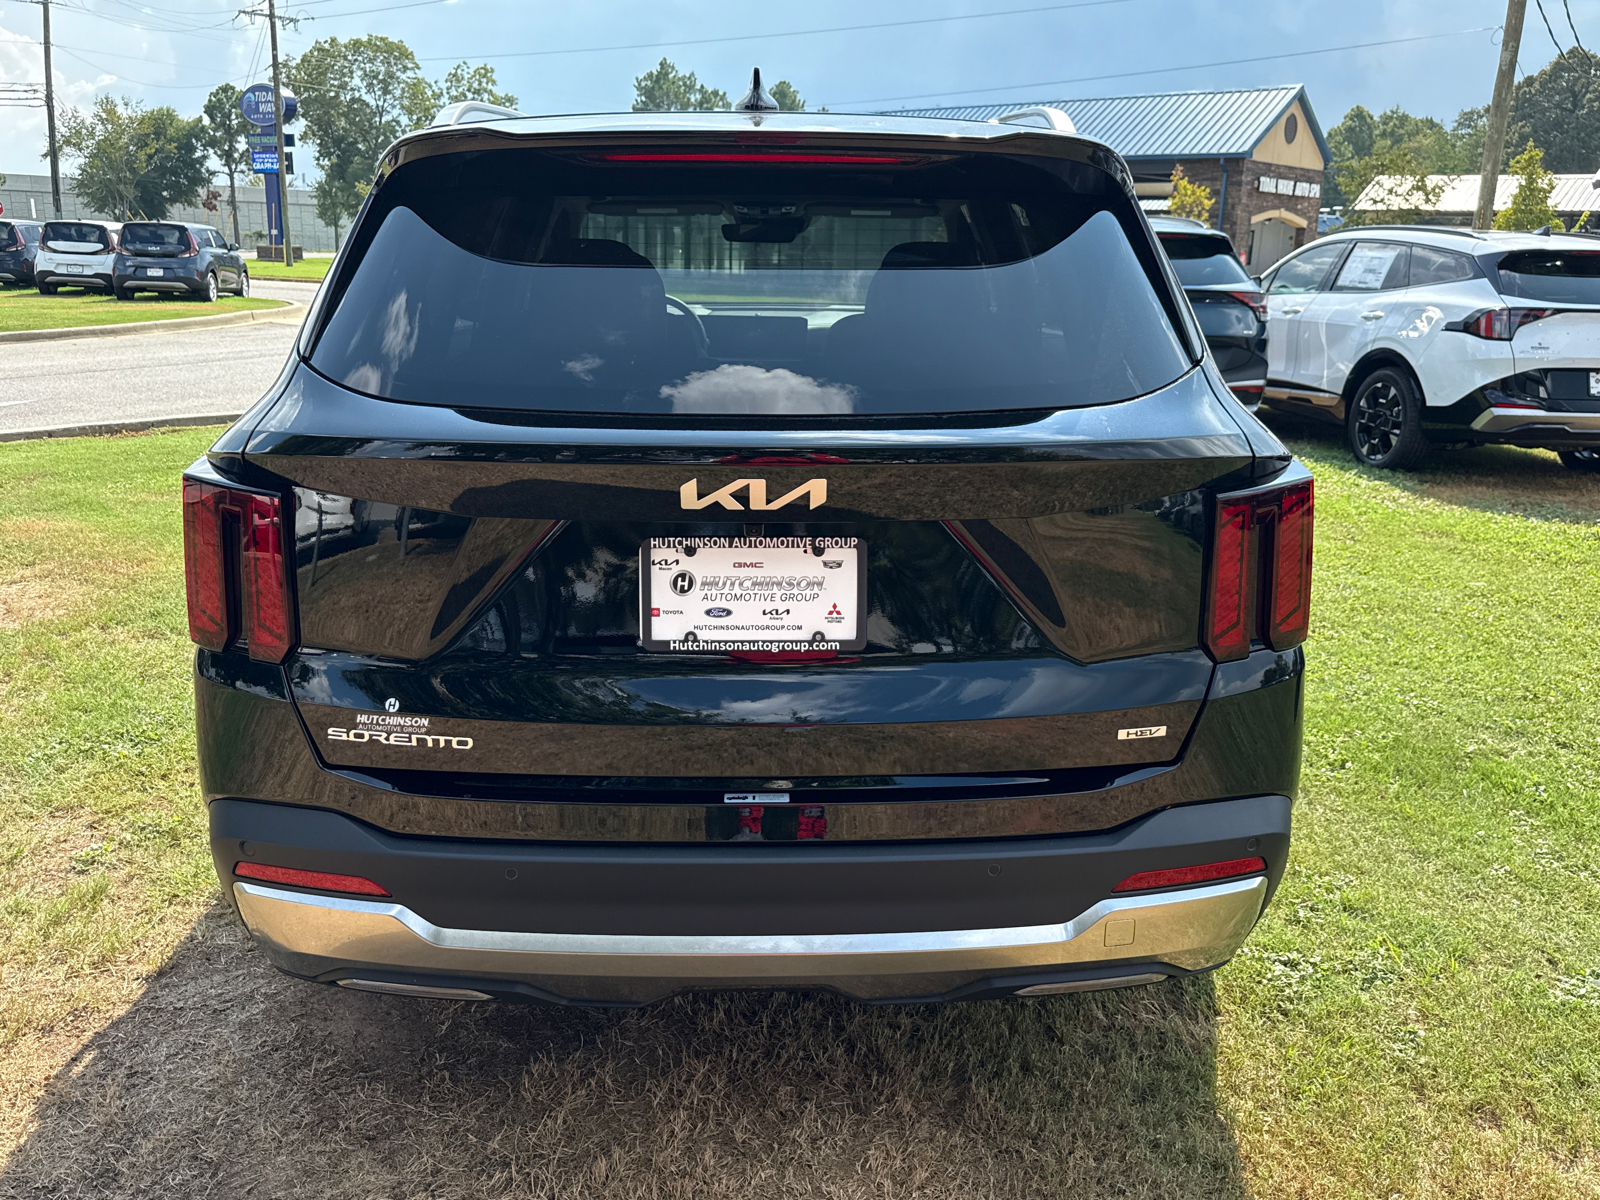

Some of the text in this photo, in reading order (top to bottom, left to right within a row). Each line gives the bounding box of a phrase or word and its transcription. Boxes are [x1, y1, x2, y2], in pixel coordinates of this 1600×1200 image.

[258, 103, 275, 113] WAV
[680, 478, 827, 510] KIA
[650, 537, 859, 549] HUTCHINSON AUTOMOTIVE GROUP
[651, 558, 680, 567] KIA
[699, 576, 826, 591] HUTCHINSON
[701, 593, 820, 602] AUTOMOTIVE GROUP
[709, 608, 728, 617] Ford
[762, 608, 791, 616] KIA
[669, 640, 840, 652] Hutchinsonautogroup.com
[356, 714, 430, 727] HUTCHINSON
[358, 724, 427, 734] AUTOMOTIVE GROUP
[1126, 728, 1162, 738] HEV
[327, 727, 474, 749] SORENTO
